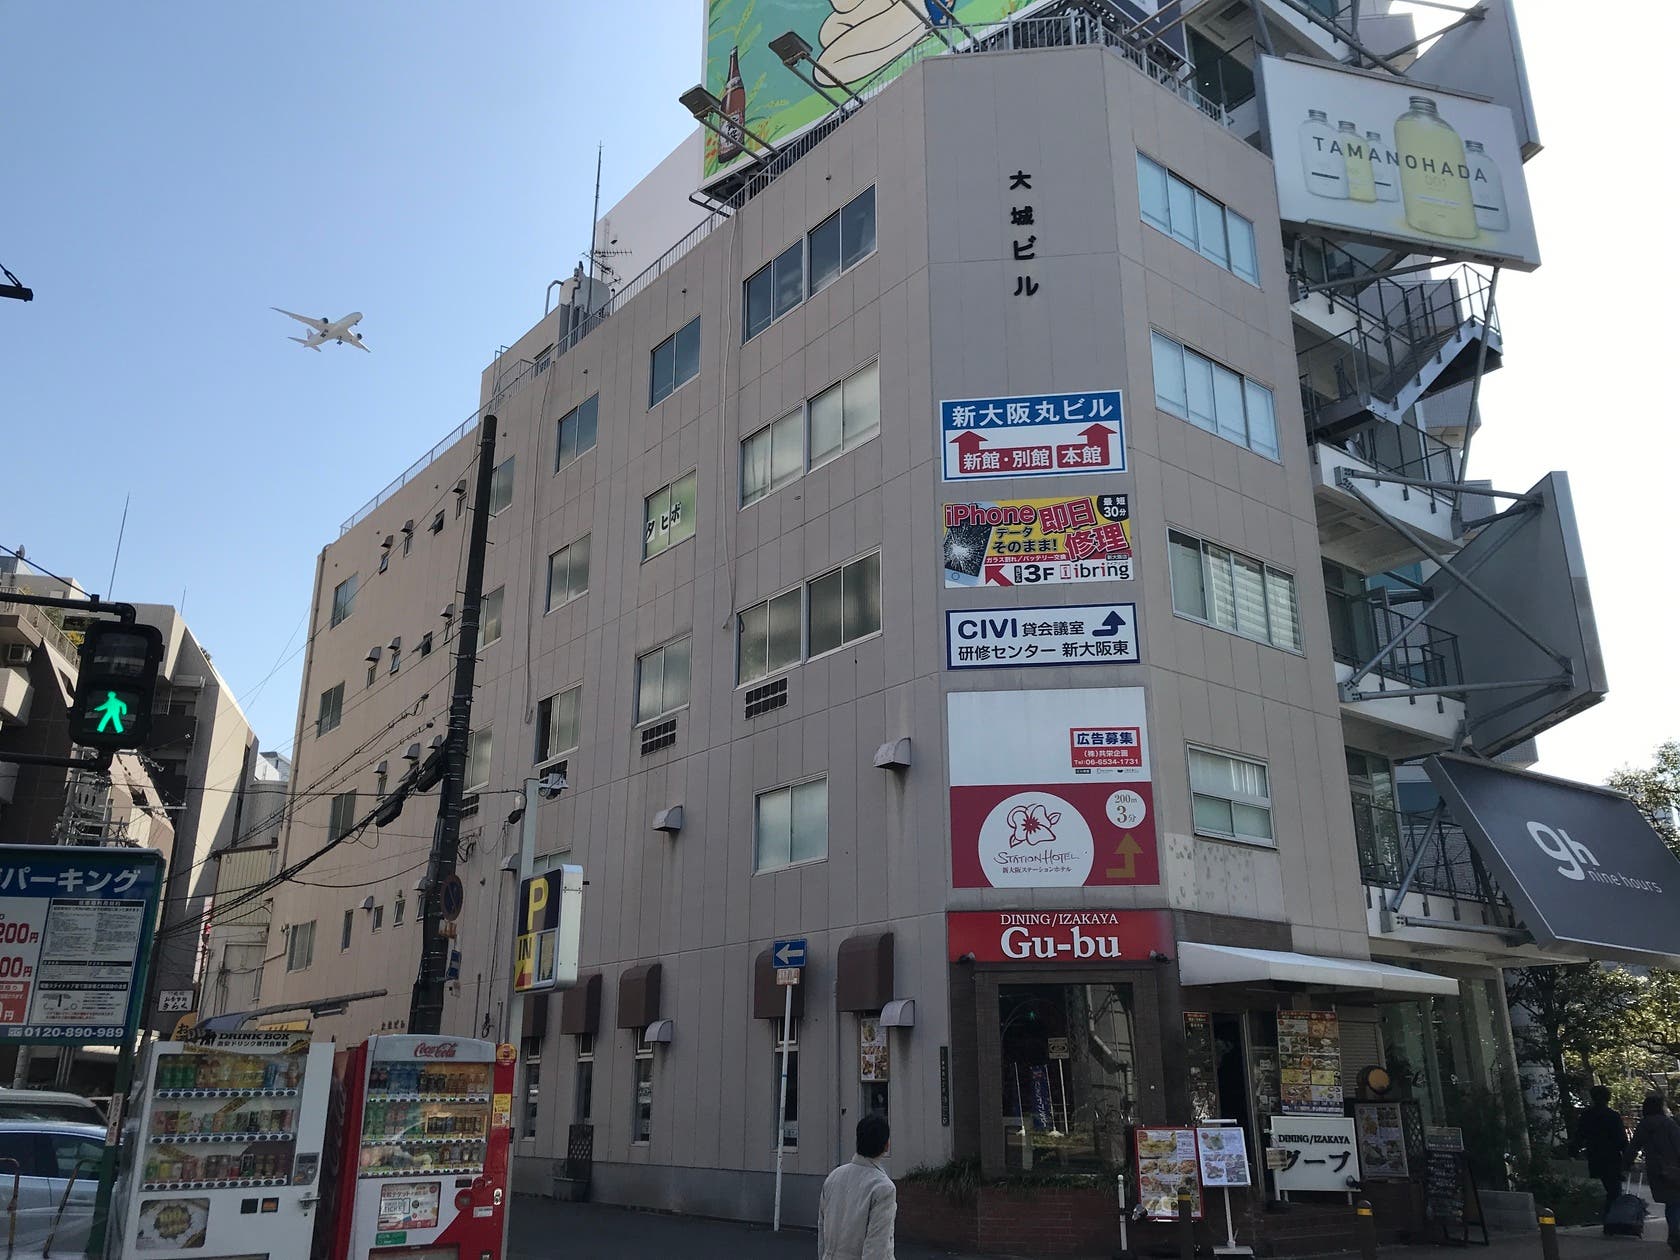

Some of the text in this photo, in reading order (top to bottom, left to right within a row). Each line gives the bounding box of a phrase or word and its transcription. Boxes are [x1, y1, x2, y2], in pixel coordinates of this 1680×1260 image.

[1312, 136, 1488, 184] TAMANOHADA
[1009, 170, 1040, 297] 大城ビル
[952, 398, 1114, 427] 新大阪丸ビル
[963, 446, 1102, 471] 新館・別館 本館
[945, 504, 1036, 527] iPhone
[1038, 497, 1097, 534] 即日
[1103, 506, 1127, 518] 30分
[996, 526, 1033, 539] データ
[1064, 521, 1129, 562] 修理
[1024, 564, 1054, 583] 3F
[1073, 562, 1130, 579] ibring
[957, 617, 1085, 640] CIVI 貸会議室
[958, 640, 1129, 662] 研修センター 新大阪東
[1077, 731, 1134, 746] 広告募集
[0, 865, 141, 894] パーキング
[1588, 867, 1663, 894] nine hours
[527, 877, 549, 933] P
[1000, 926, 1122, 960] Gu-bu
[24, 1027, 124, 1038] 0120-890-989
[414, 1042, 457, 1058] Coca-Cola
